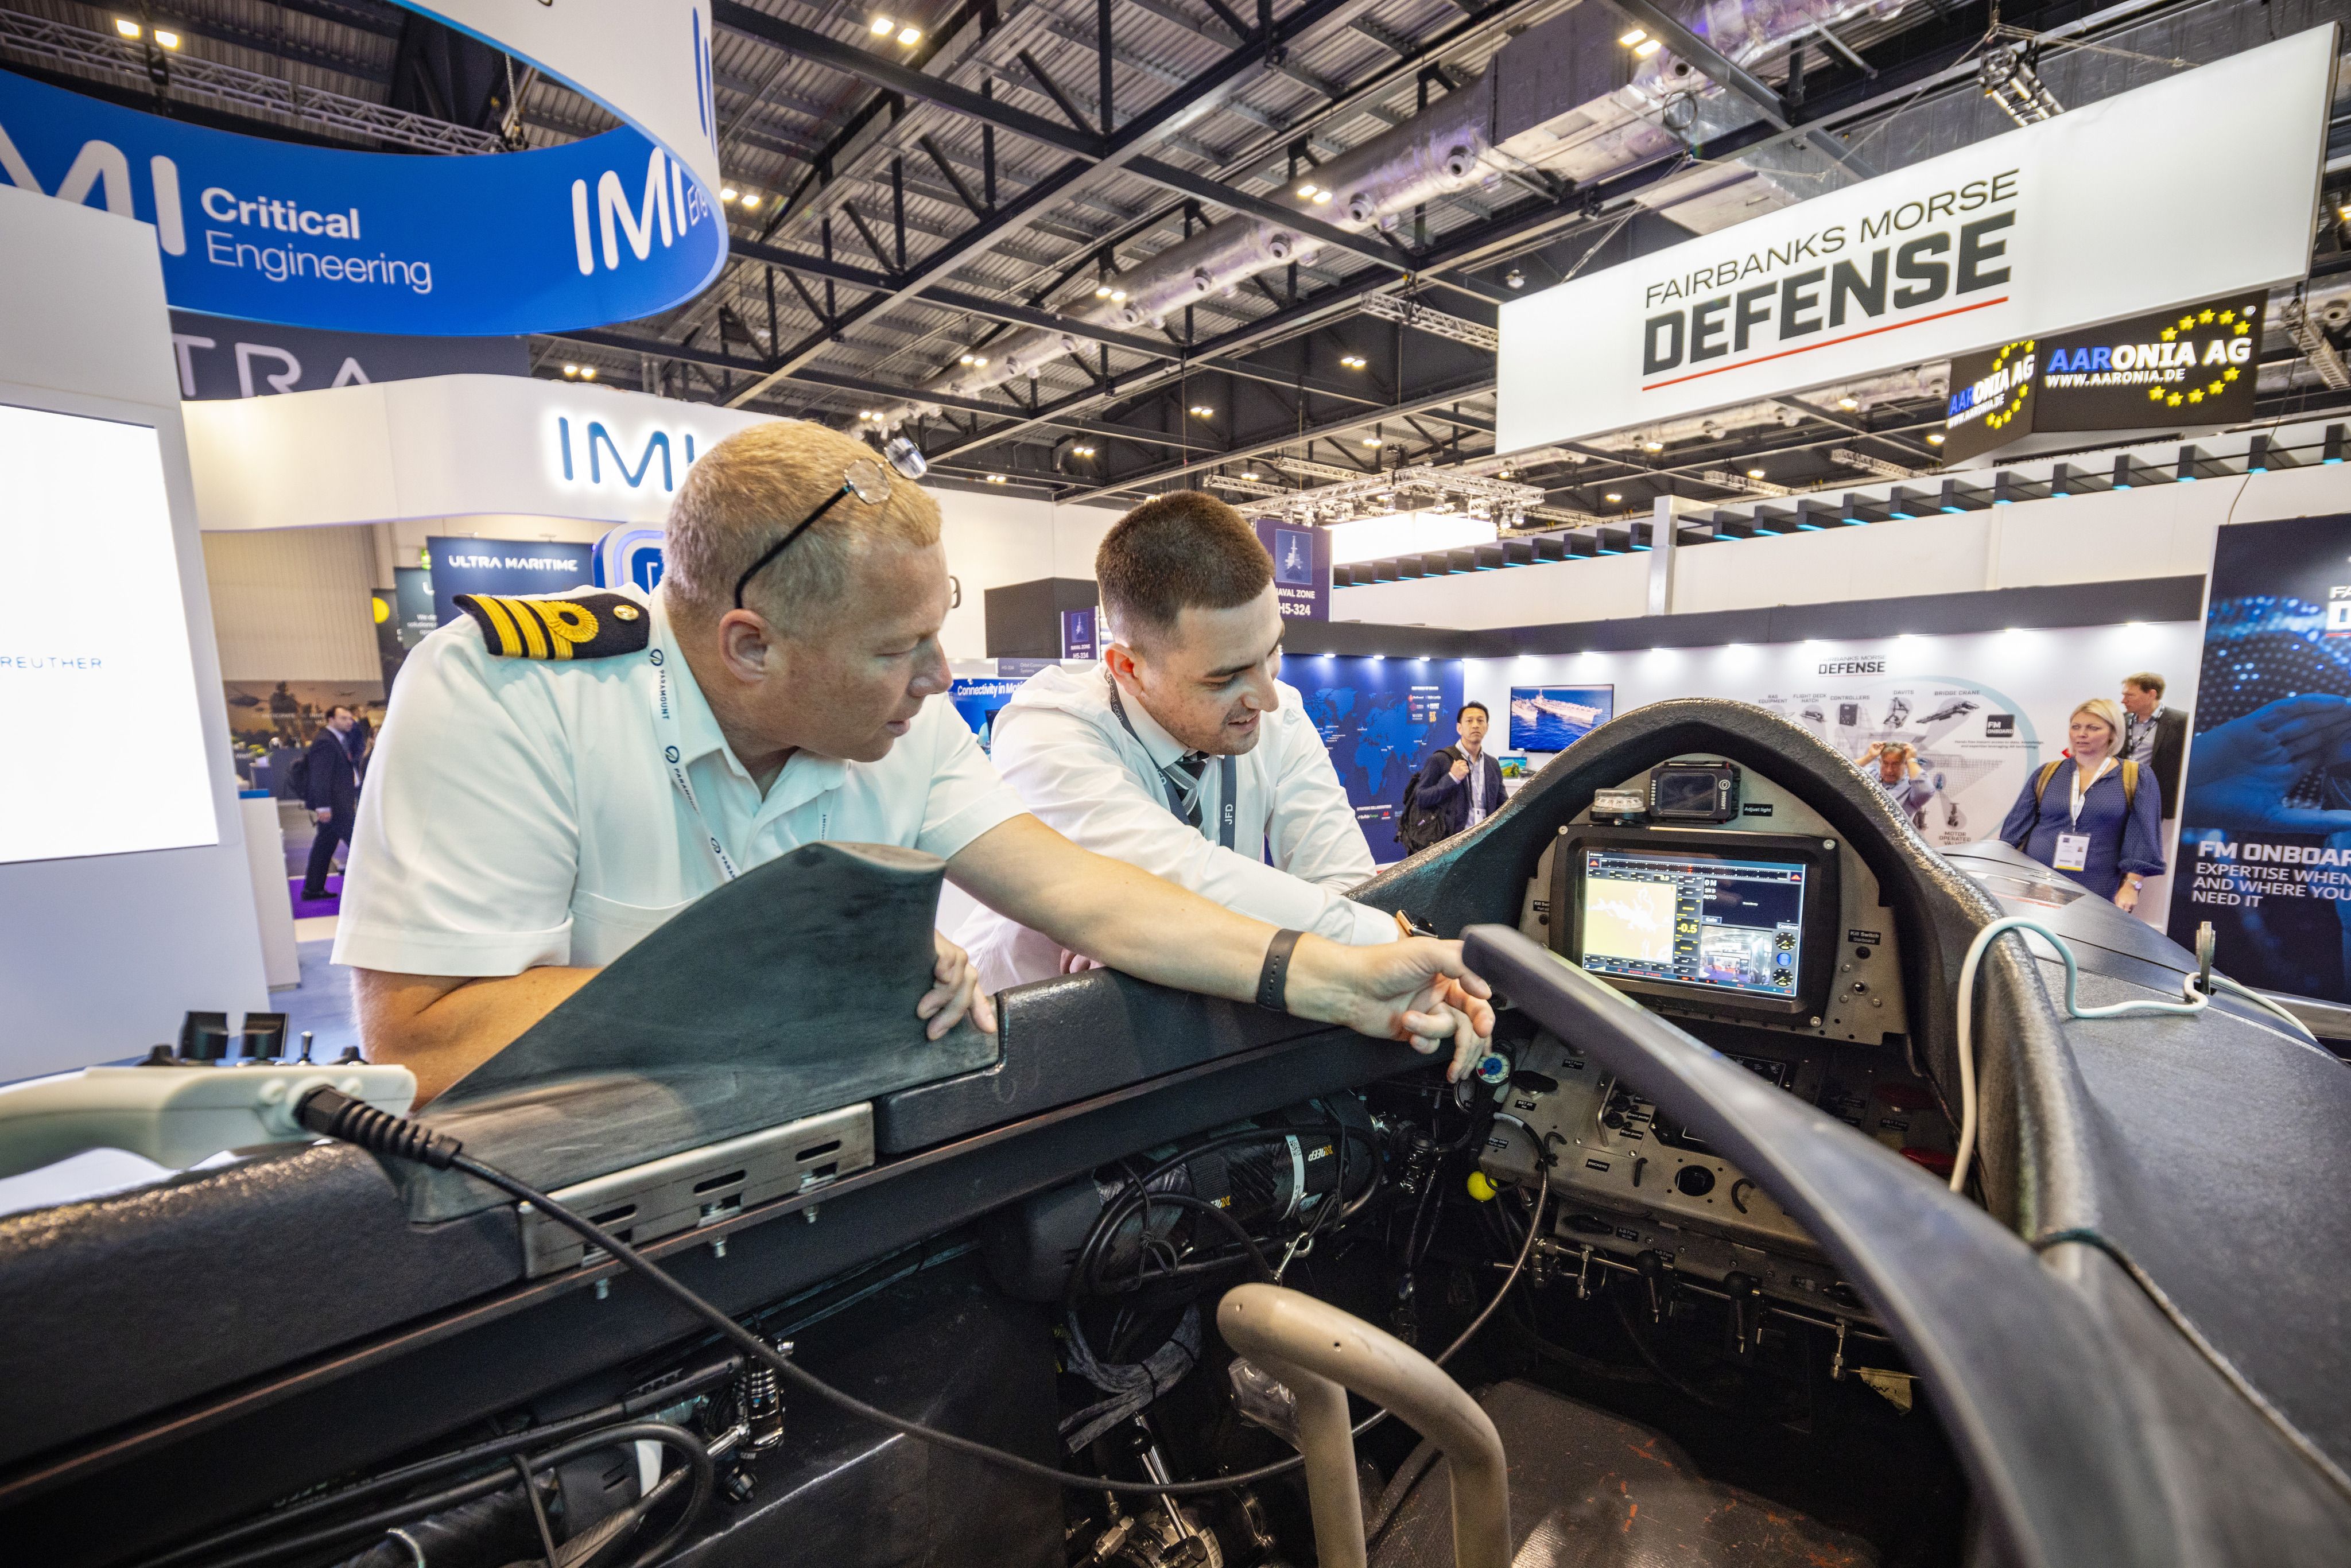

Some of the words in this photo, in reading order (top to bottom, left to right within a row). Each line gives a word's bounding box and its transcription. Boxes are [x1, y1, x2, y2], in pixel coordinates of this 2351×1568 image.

[201, 187, 360, 240] Critical
[572, 146, 686, 275] IMI
[1645, 226, 1846, 309] FAIRBANKS
[1860, 168, 2020, 240] MORSE
[207, 230, 432, 294] Engineering
[1642, 209, 2016, 376] DEFENSE
[2047, 342, 2197, 373] AARONIA
[2202, 337, 2252, 366] AG
[1949, 368, 2009, 416] AARONIA
[2011, 354, 2035, 387] AG
[2045, 368, 2186, 389] WWW.AARONIA.DE
[1946, 393, 2005, 430] WWW.AARONIA.DE
[448, 555, 502, 569] ULTRA
[505, 557, 578, 572] MARITIME
[1296, 589, 1316, 599] ZONE
[1278, 603, 1311, 616] H5-324
[0, 657, 102, 669] REUTHER
[1818, 662, 1886, 674] DEFENSE
[659, 670, 670, 720] PARAMOUNT
[957, 682, 997, 698] Connectivity
[998, 682, 1006, 694] in
[1224, 804, 1233, 825] JFD
[2198, 840, 2238, 859] FM
[2195, 862, 2290, 881] EXPERTISE
[2191, 890, 2241, 906] NEED
[2244, 895, 2264, 907] IT
[2193, 877, 2234, 890] AND
[2239, 880, 2307, 898] WHERE
[2311, 886, 2351, 901] YOU
[1677, 923, 1698, 934] -0.5
